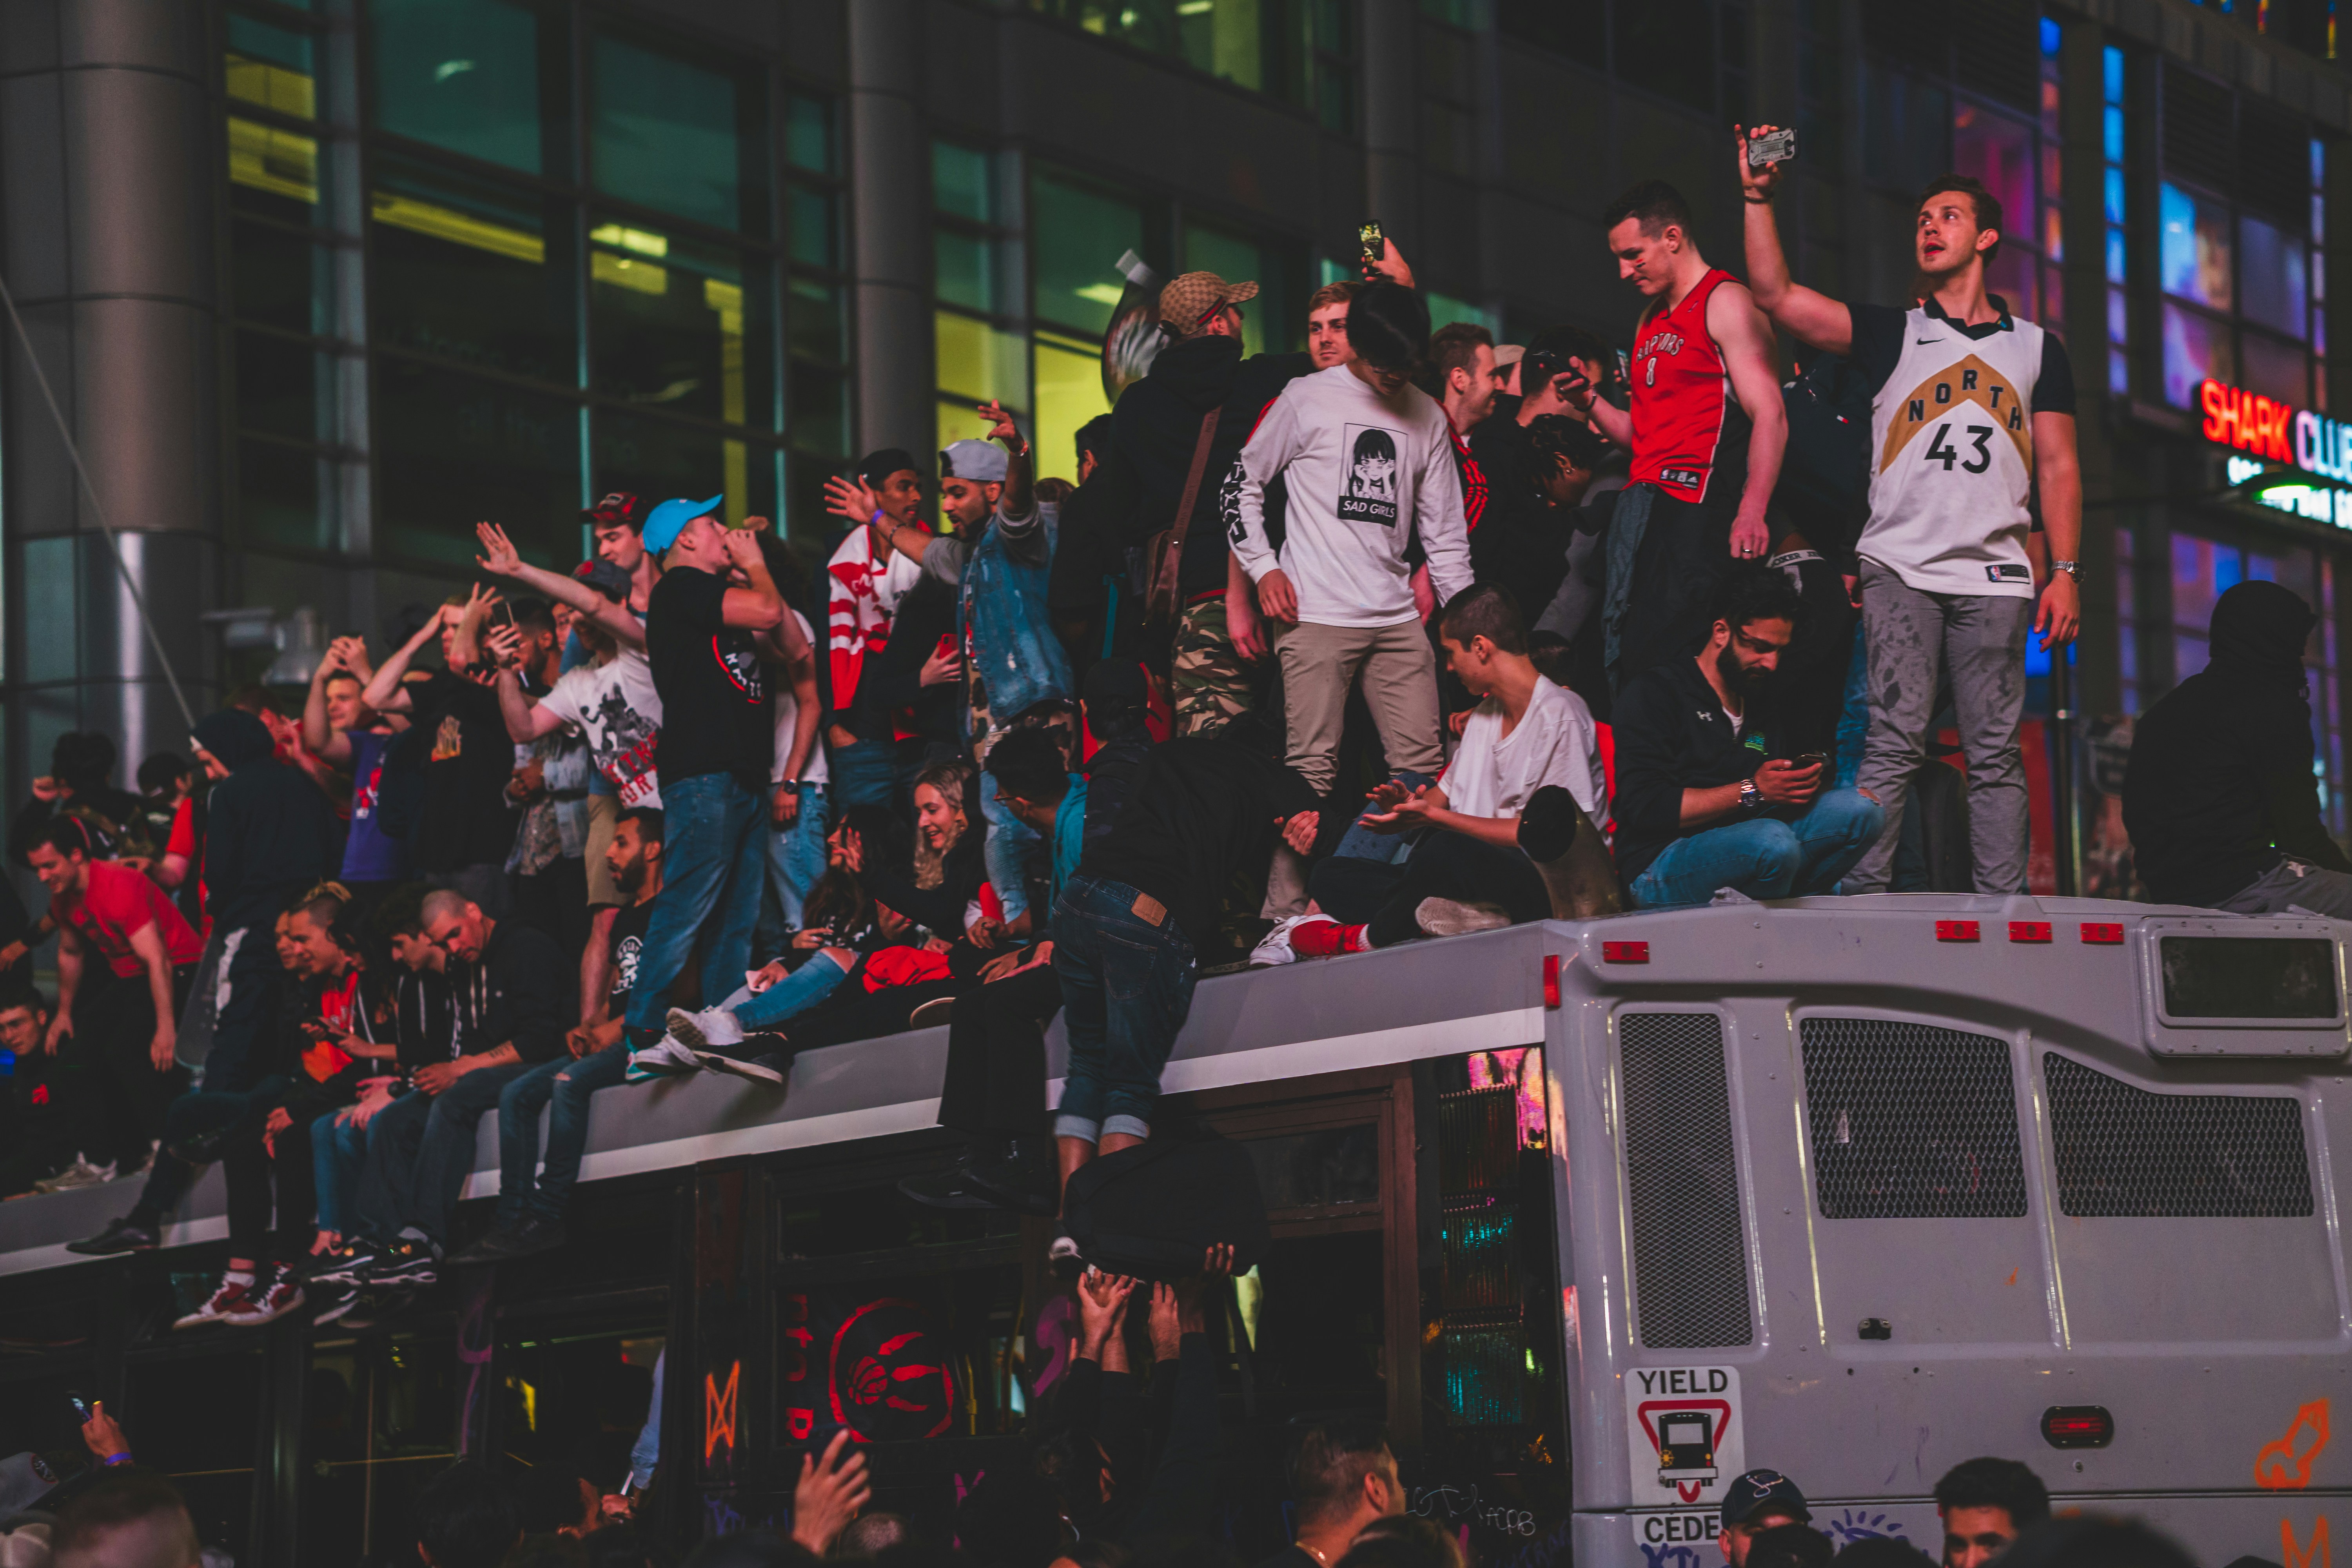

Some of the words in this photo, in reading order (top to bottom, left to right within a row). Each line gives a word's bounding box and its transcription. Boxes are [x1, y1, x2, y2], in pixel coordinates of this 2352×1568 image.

[1636, 332, 1684, 364] RAPTORS
[1646, 356, 1657, 388] 8
[1908, 369, 2022, 431] NORTH
[2201, 377, 2293, 464] SHARK
[1924, 423, 1993, 474] 43
[1343, 501, 1368, 512] SAD
[1370, 504, 1396, 518] GIRLS
[1637, 1369, 1728, 1394] YIELD
